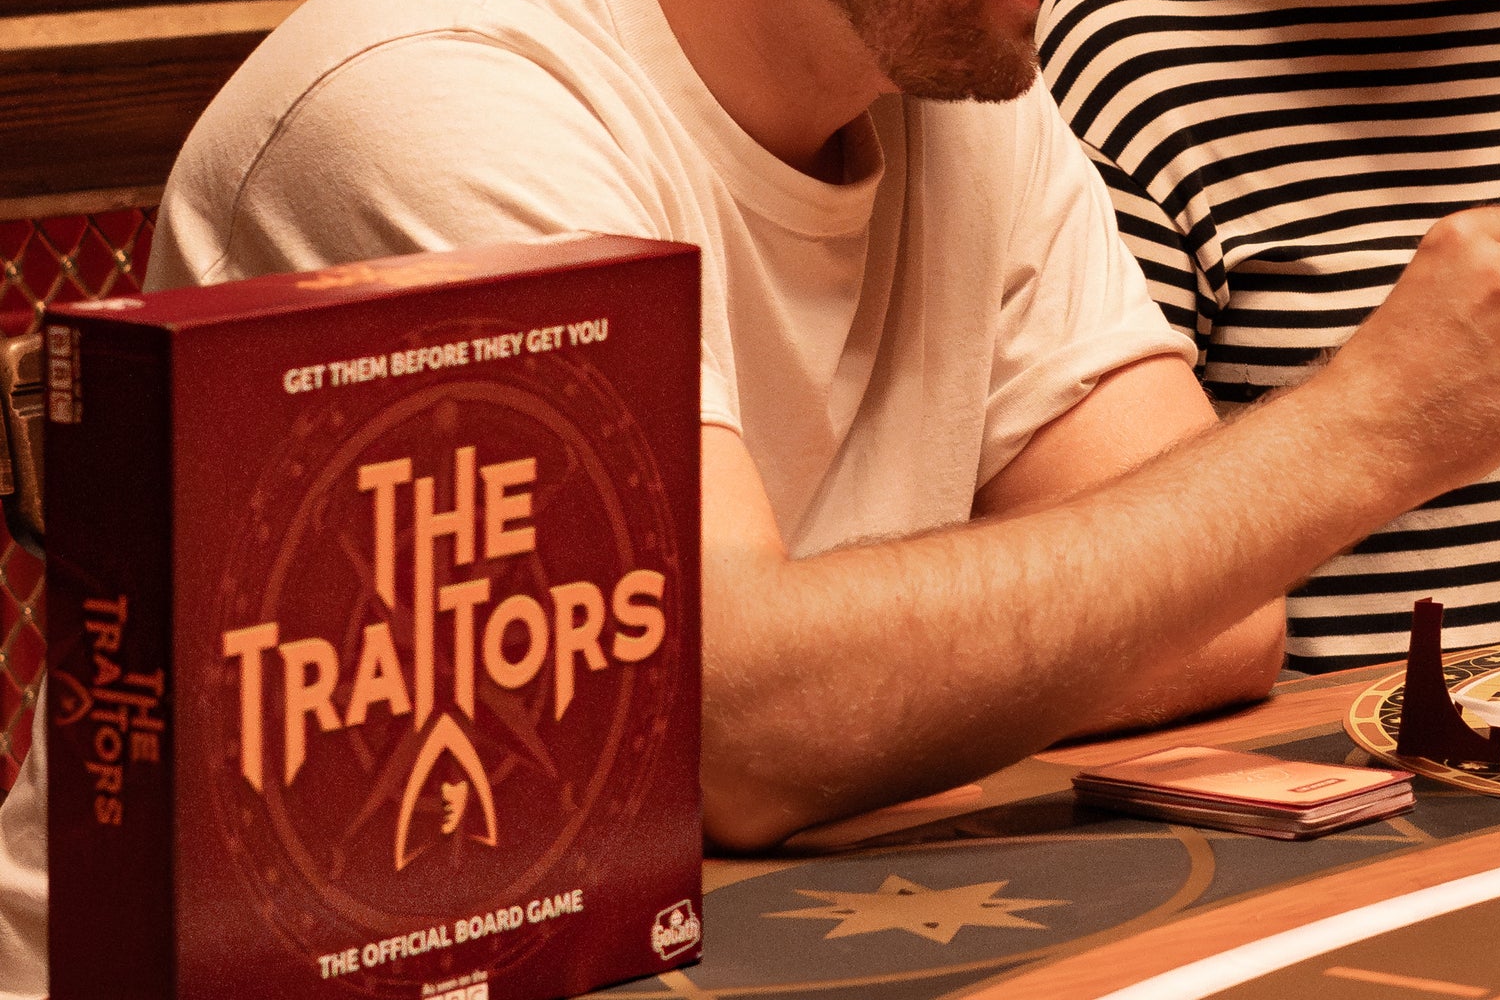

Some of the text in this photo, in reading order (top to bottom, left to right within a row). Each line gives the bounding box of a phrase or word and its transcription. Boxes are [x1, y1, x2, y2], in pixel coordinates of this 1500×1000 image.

[283, 318, 609, 394] GET THEM BEFORE THEY GET YOU
[358, 446, 537, 611] THE
[83, 594, 128, 826] TRAITORS
[124, 667, 166, 763] THE
[223, 569, 666, 793] TRAITORS
[318, 889, 584, 979] THE OFFICIAL BOARD GAME
